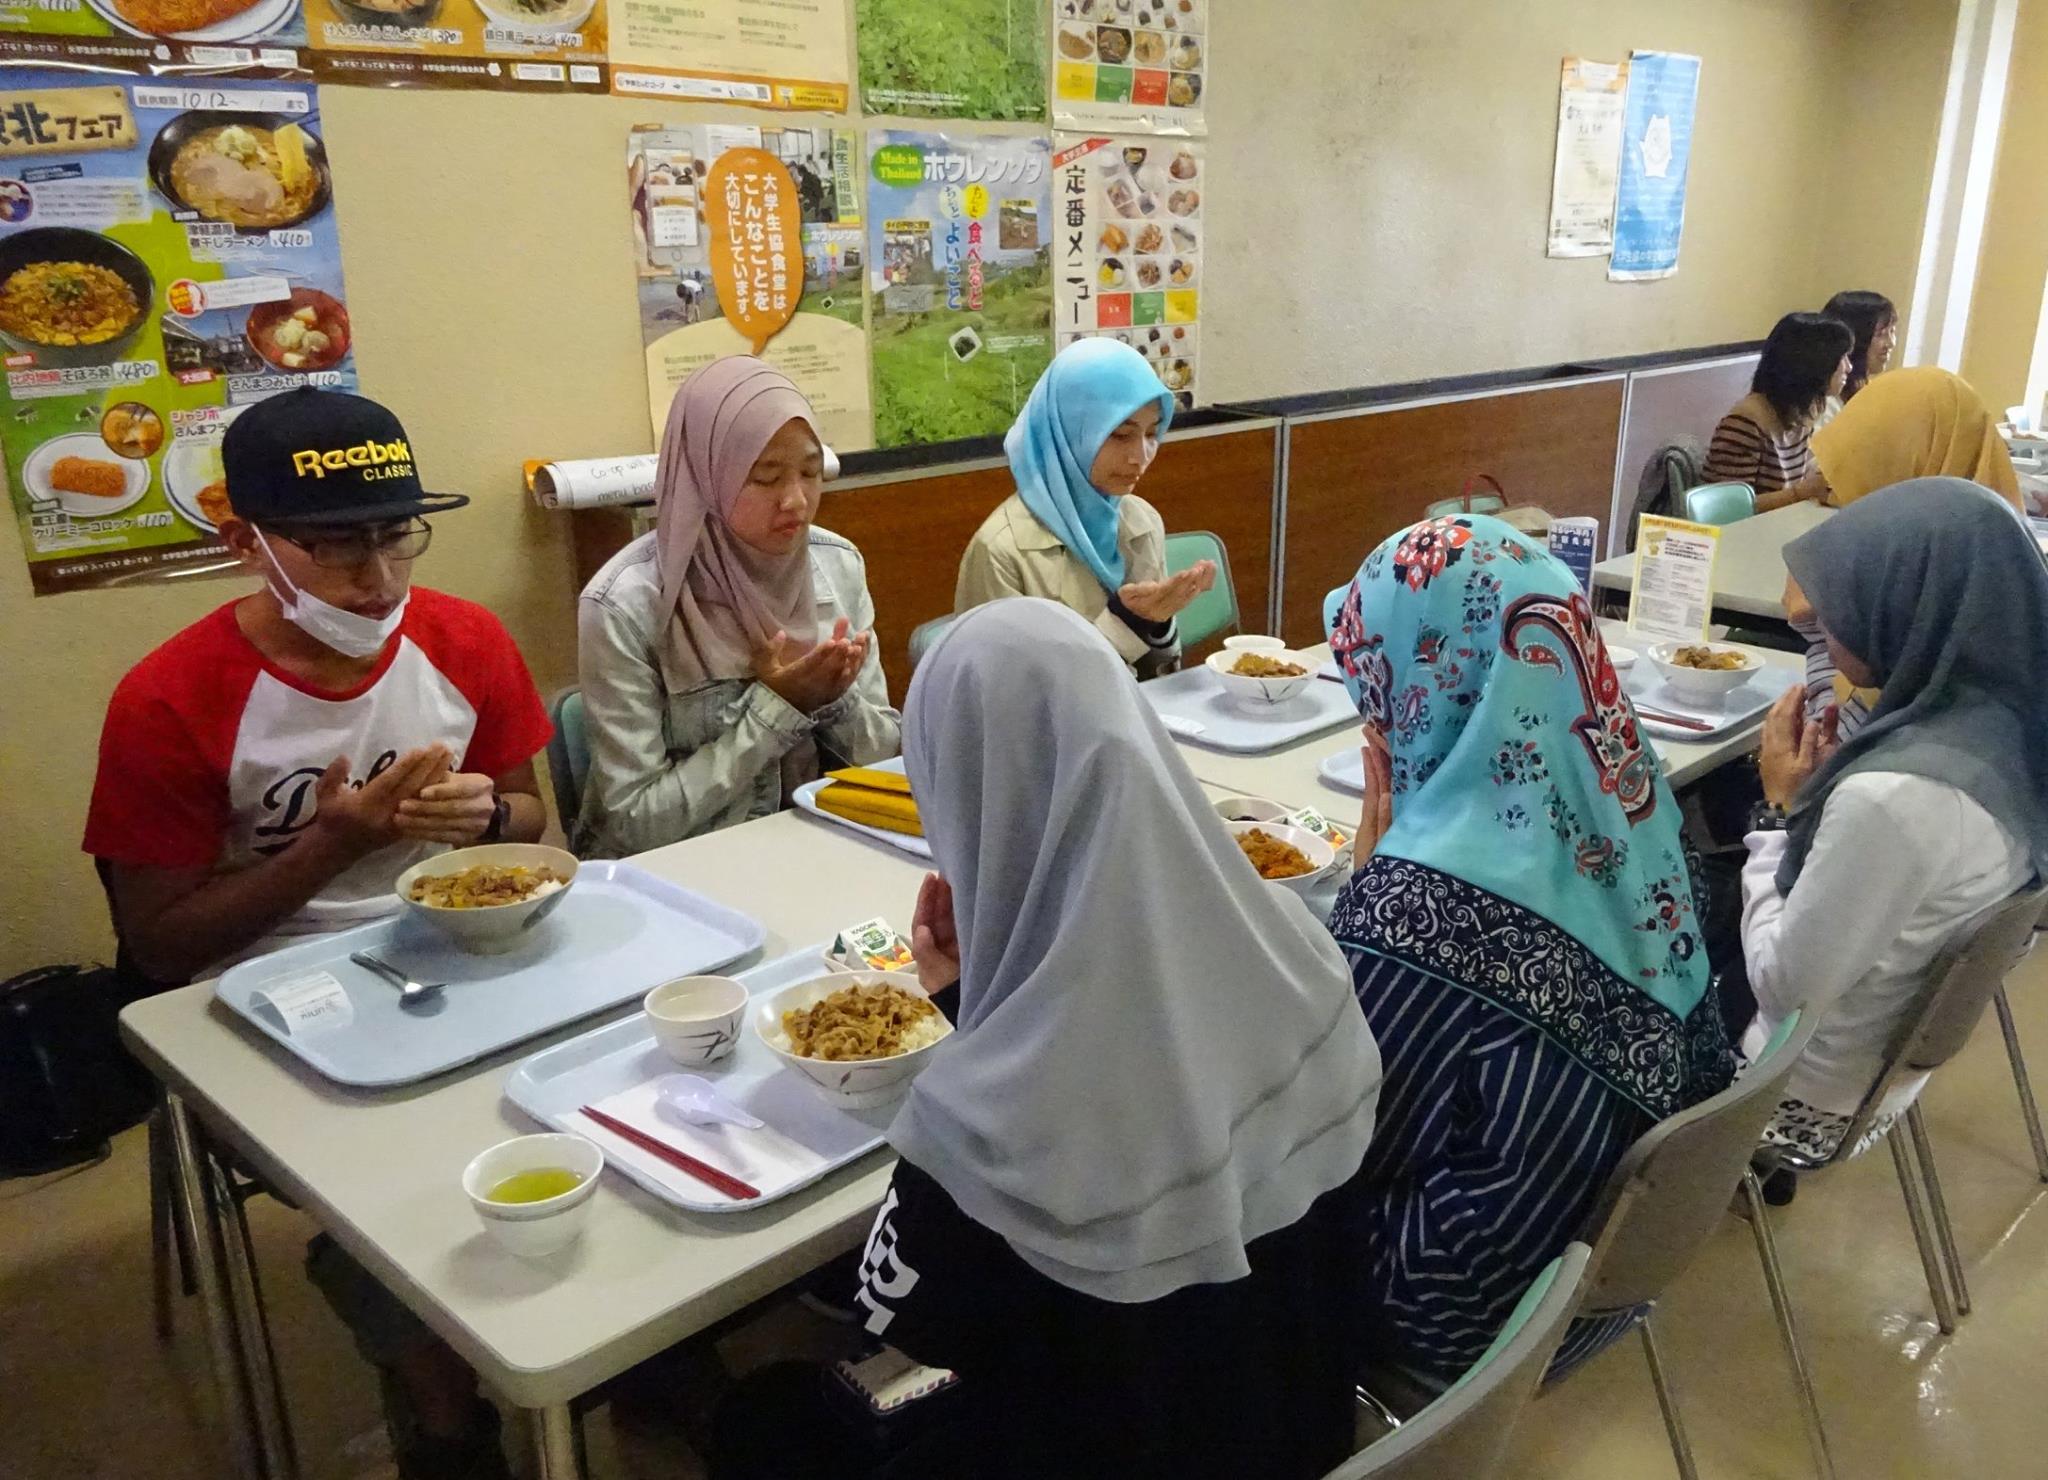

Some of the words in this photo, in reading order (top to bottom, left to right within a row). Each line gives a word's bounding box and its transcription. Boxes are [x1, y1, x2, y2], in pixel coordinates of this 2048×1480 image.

[724, 172, 752, 322] 大切にしています。
[743, 174, 770, 312] こんなことを
[763, 172, 788, 319] 大学生協食堂は、
[1065, 165, 1090, 324] 定番メニュー
[292, 438, 410, 478] Reebok
